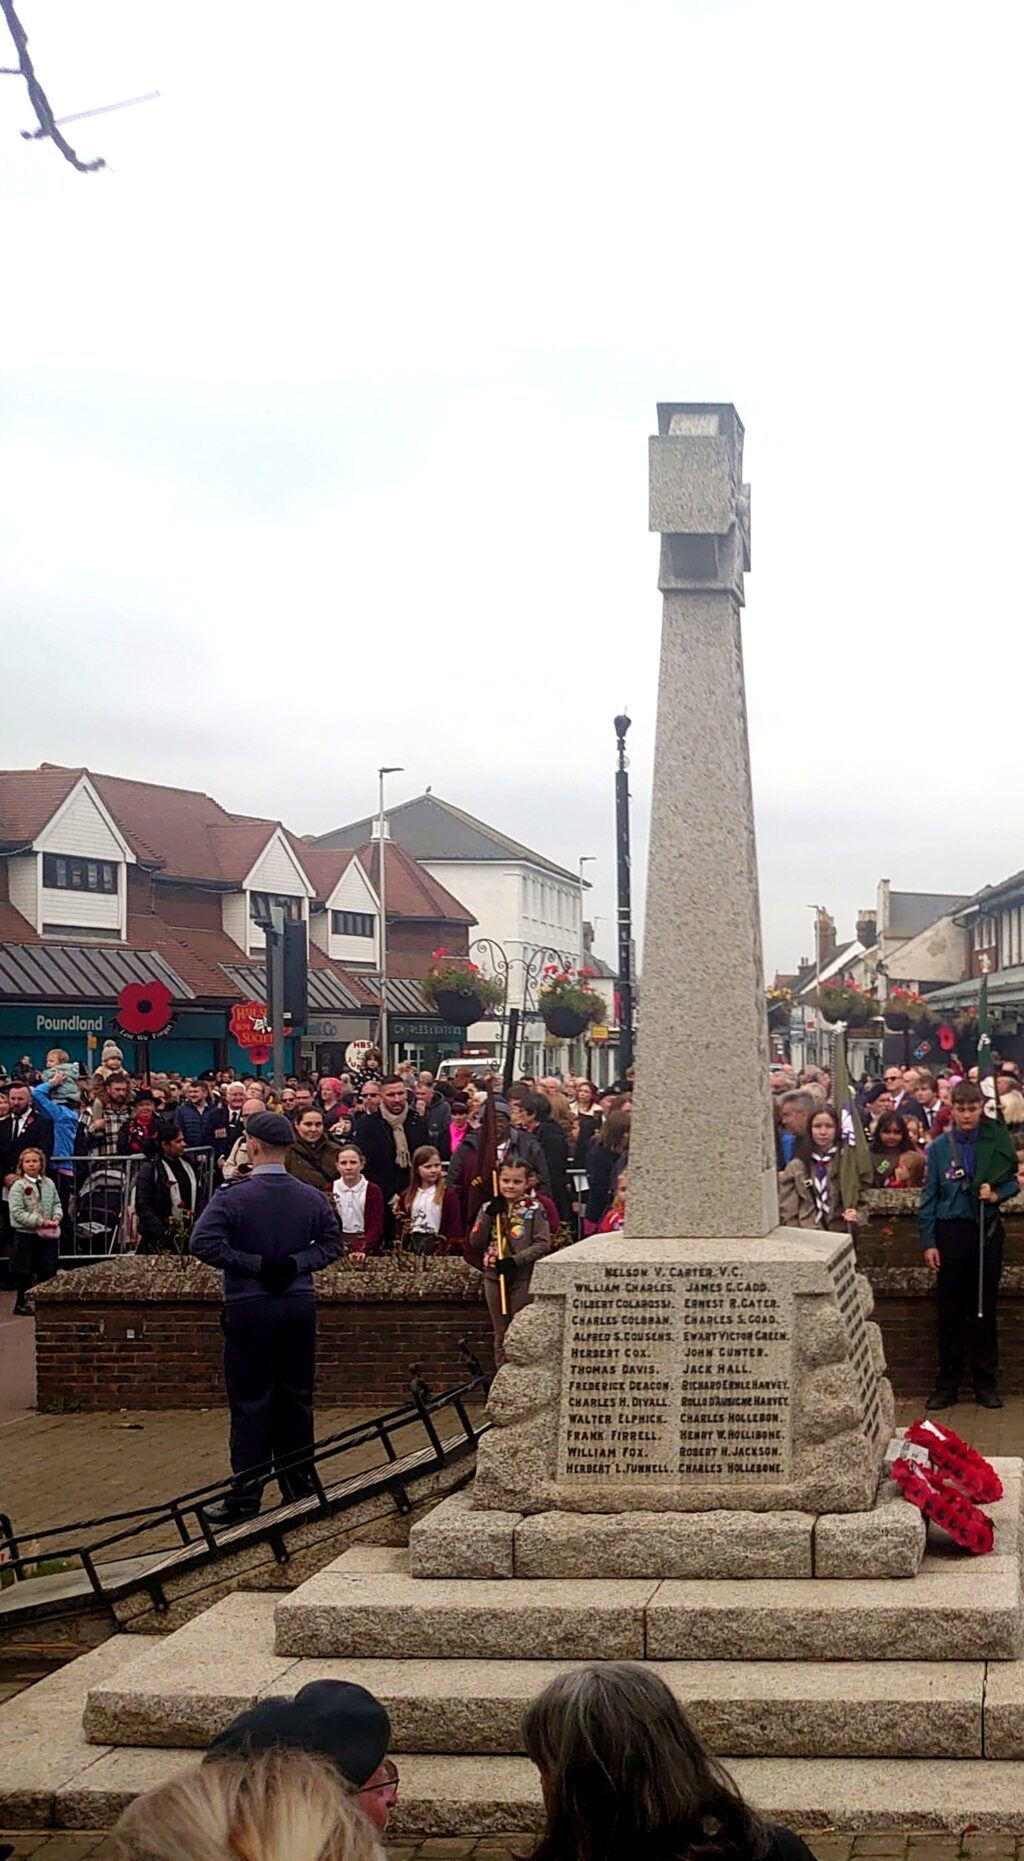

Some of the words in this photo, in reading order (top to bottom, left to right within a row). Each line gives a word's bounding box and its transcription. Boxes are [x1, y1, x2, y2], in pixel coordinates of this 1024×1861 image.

[36, 1015, 103, 1031] Poundland
[151, 1024, 173, 1039] Forget
[242, 1033, 273, 1043] SOCIET
[605, 1267, 647, 1277] NELSON
[719, 1267, 743, 1277] V.C.
[575, 1283, 620, 1292] WILLIAM
[626, 1283, 676, 1292] CHARLES.
[686, 1283, 722, 1292] JAMES
[685, 1299, 724, 1308] ERNEST
[572, 1316, 617, 1325] CHARLES
[684, 1315, 733, 1325] CHARLES
[574, 1332, 610, 1341] ALFRED
[683, 1331, 716, 1341] EWART
[719, 1331, 752, 1341] VICTOR
[571, 1348, 619, 1358] HERBERT
[625, 1348, 651, 1358] COX.
[684, 1348, 712, 1357] JOHN
[571, 1365, 616, 1374] THOMAS
[622, 1365, 659, 1374] DAVIS.
[683, 1364, 712, 1374] JACK
[717, 1364, 752, 1374] HALL.
[569, 1381, 625, 1391] FREDERICK
[629, 1381, 673, 1391] DEACON.
[681, 1380, 721, 1390] RICHARD
[569, 1398, 616, 1407] CHARLES
[568, 1414, 611, 1424] WALTER
[680, 1413, 724, 1423] CHARLES
[567, 1431, 604, 1441] FRANK
[611, 1431, 661, 1441] FIRRELL.
[680, 1430, 713, 1440] HENRY
[568, 1448, 616, 1457] WILLIAM
[623, 1448, 648, 1457] FOX.
[680, 1447, 717, 1457] ROBERT
[566, 1464, 610, 1474] HERBERT
[679, 1464, 722, 1473] CHARLES
